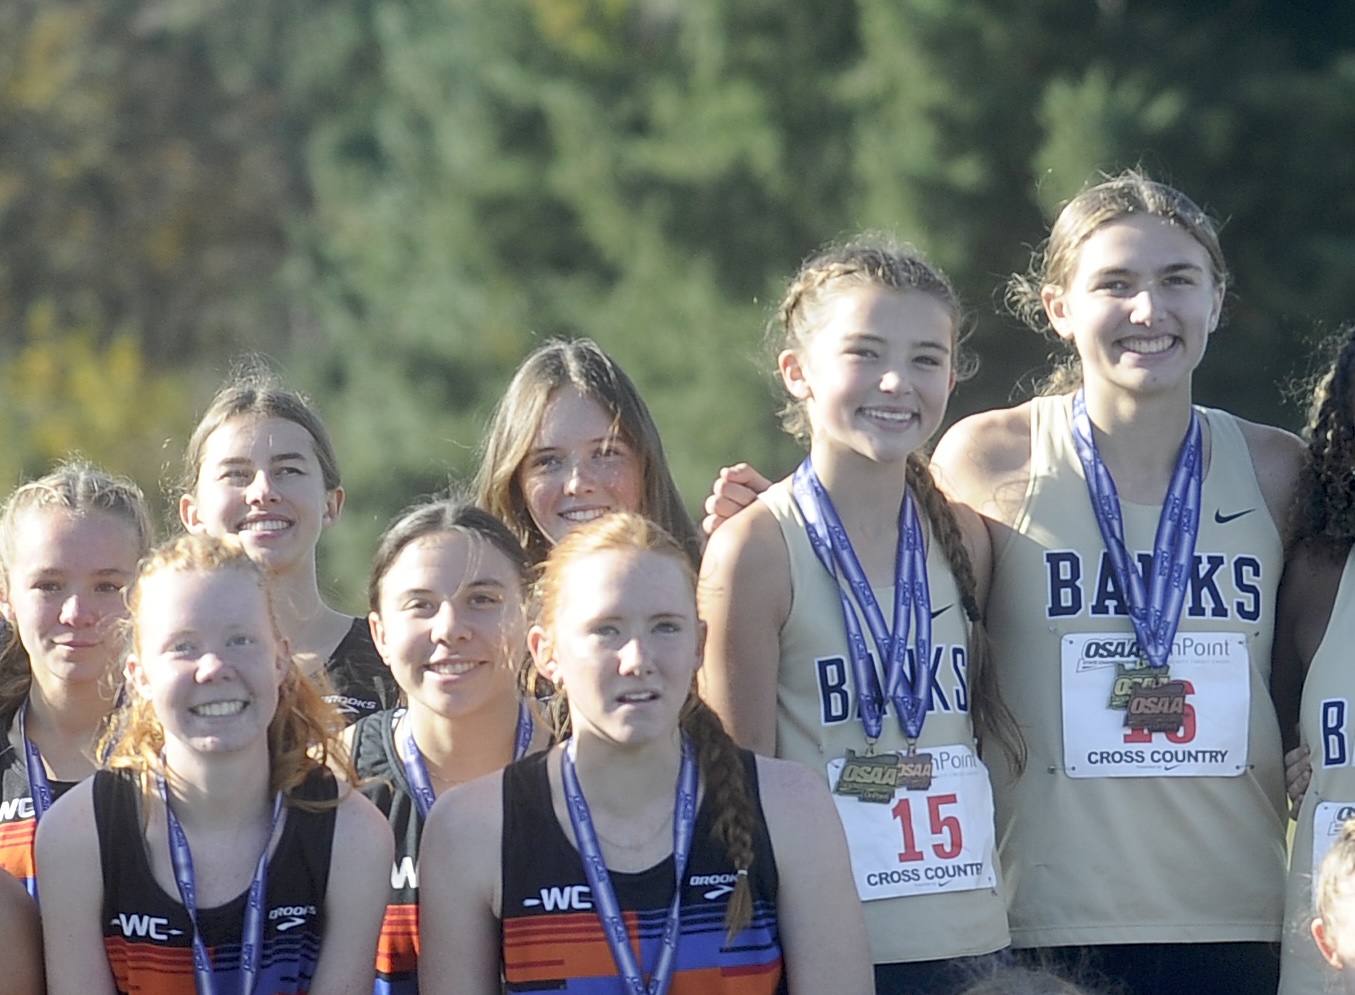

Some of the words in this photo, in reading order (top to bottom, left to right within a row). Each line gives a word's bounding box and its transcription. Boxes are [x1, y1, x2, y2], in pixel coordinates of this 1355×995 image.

[1171, 638, 1230, 656] nPoint
[1124, 680, 1197, 744] 6
[1131, 696, 1184, 715] OSAA
[932, 751, 977, 771] nPoint
[1088, 751, 1145, 765] CROSS
[1151, 750, 1229, 764] COUNTRY
[842, 764, 898, 786] OSAA
[891, 793, 963, 863] 15
[391, 857, 419, 889] W
[689, 873, 739, 887] BROOK
[867, 868, 921, 886] CROSS
[924, 862, 983, 881] COUNTR
